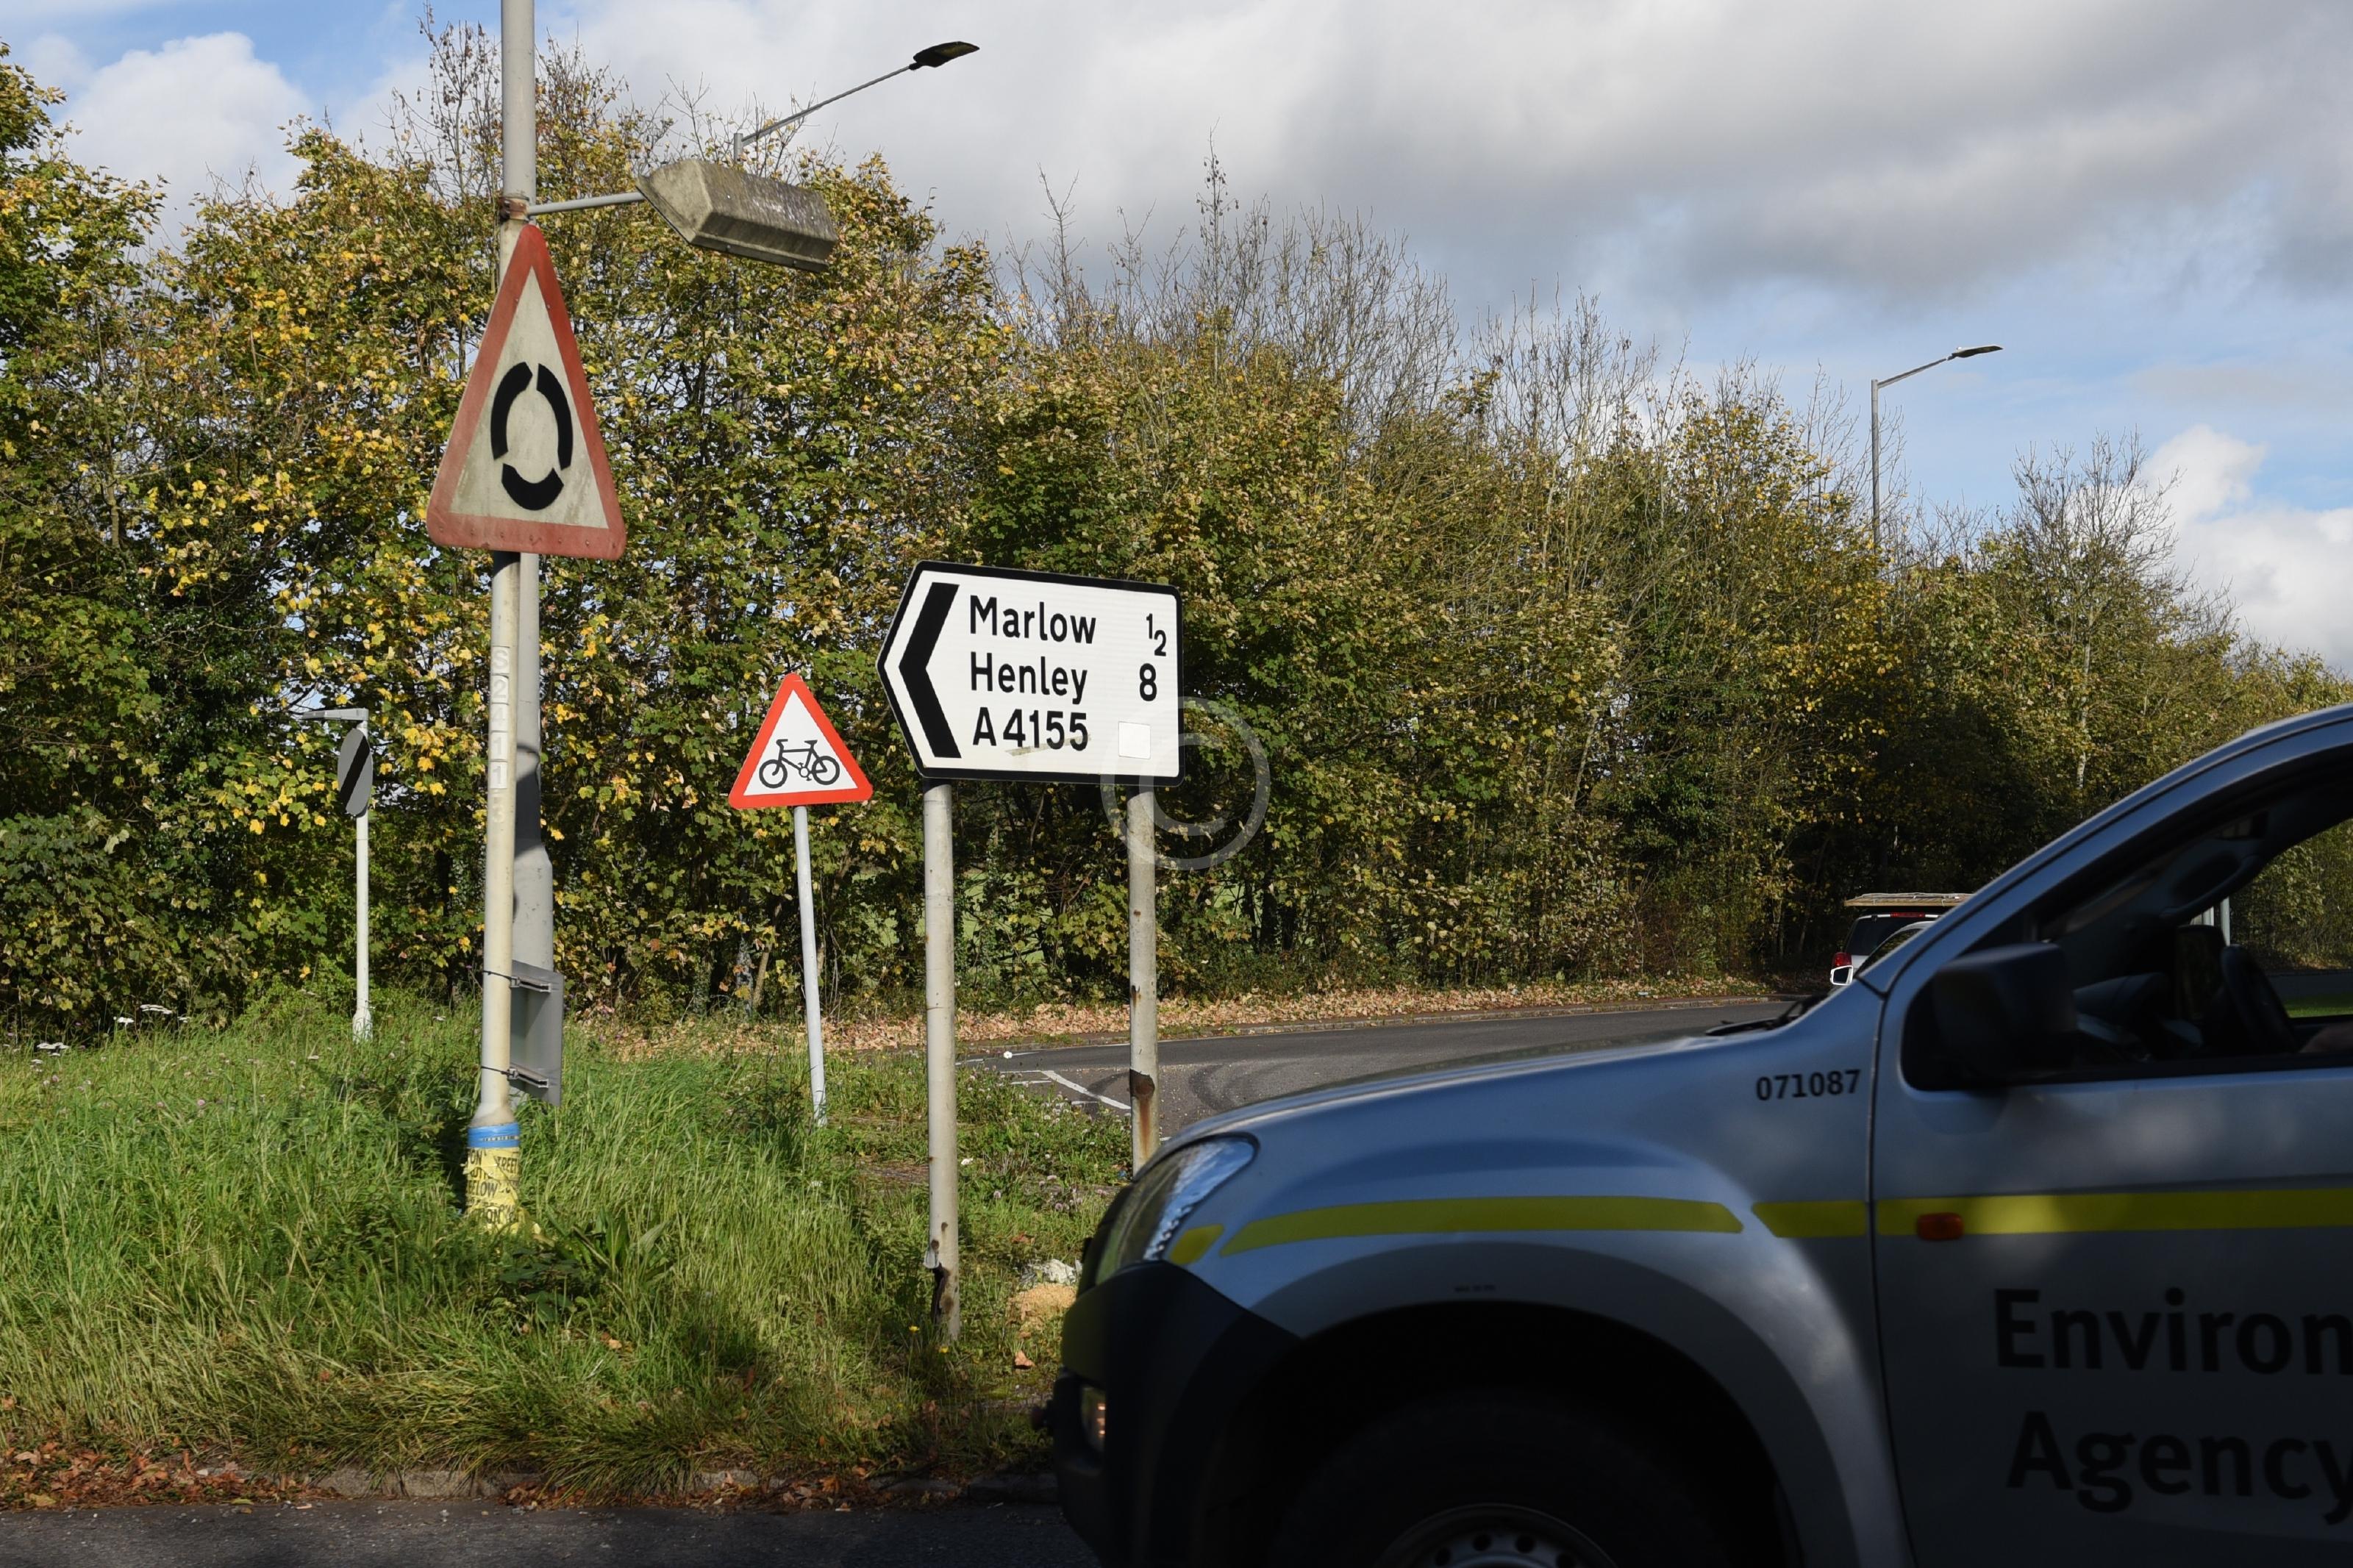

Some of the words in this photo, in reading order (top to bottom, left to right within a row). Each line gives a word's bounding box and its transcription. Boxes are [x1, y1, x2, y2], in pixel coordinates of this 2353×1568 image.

[970, 595, 1096, 644] Marlow
[971, 651, 1088, 704] Henley
[1139, 663, 1157, 701] 8
[973, 706, 1089, 751] A4155
[1756, 1069, 1860, 1100] 071087
[1995, 1287, 2353, 1375] Environ
[2006, 1411, 2353, 1525] Agency
